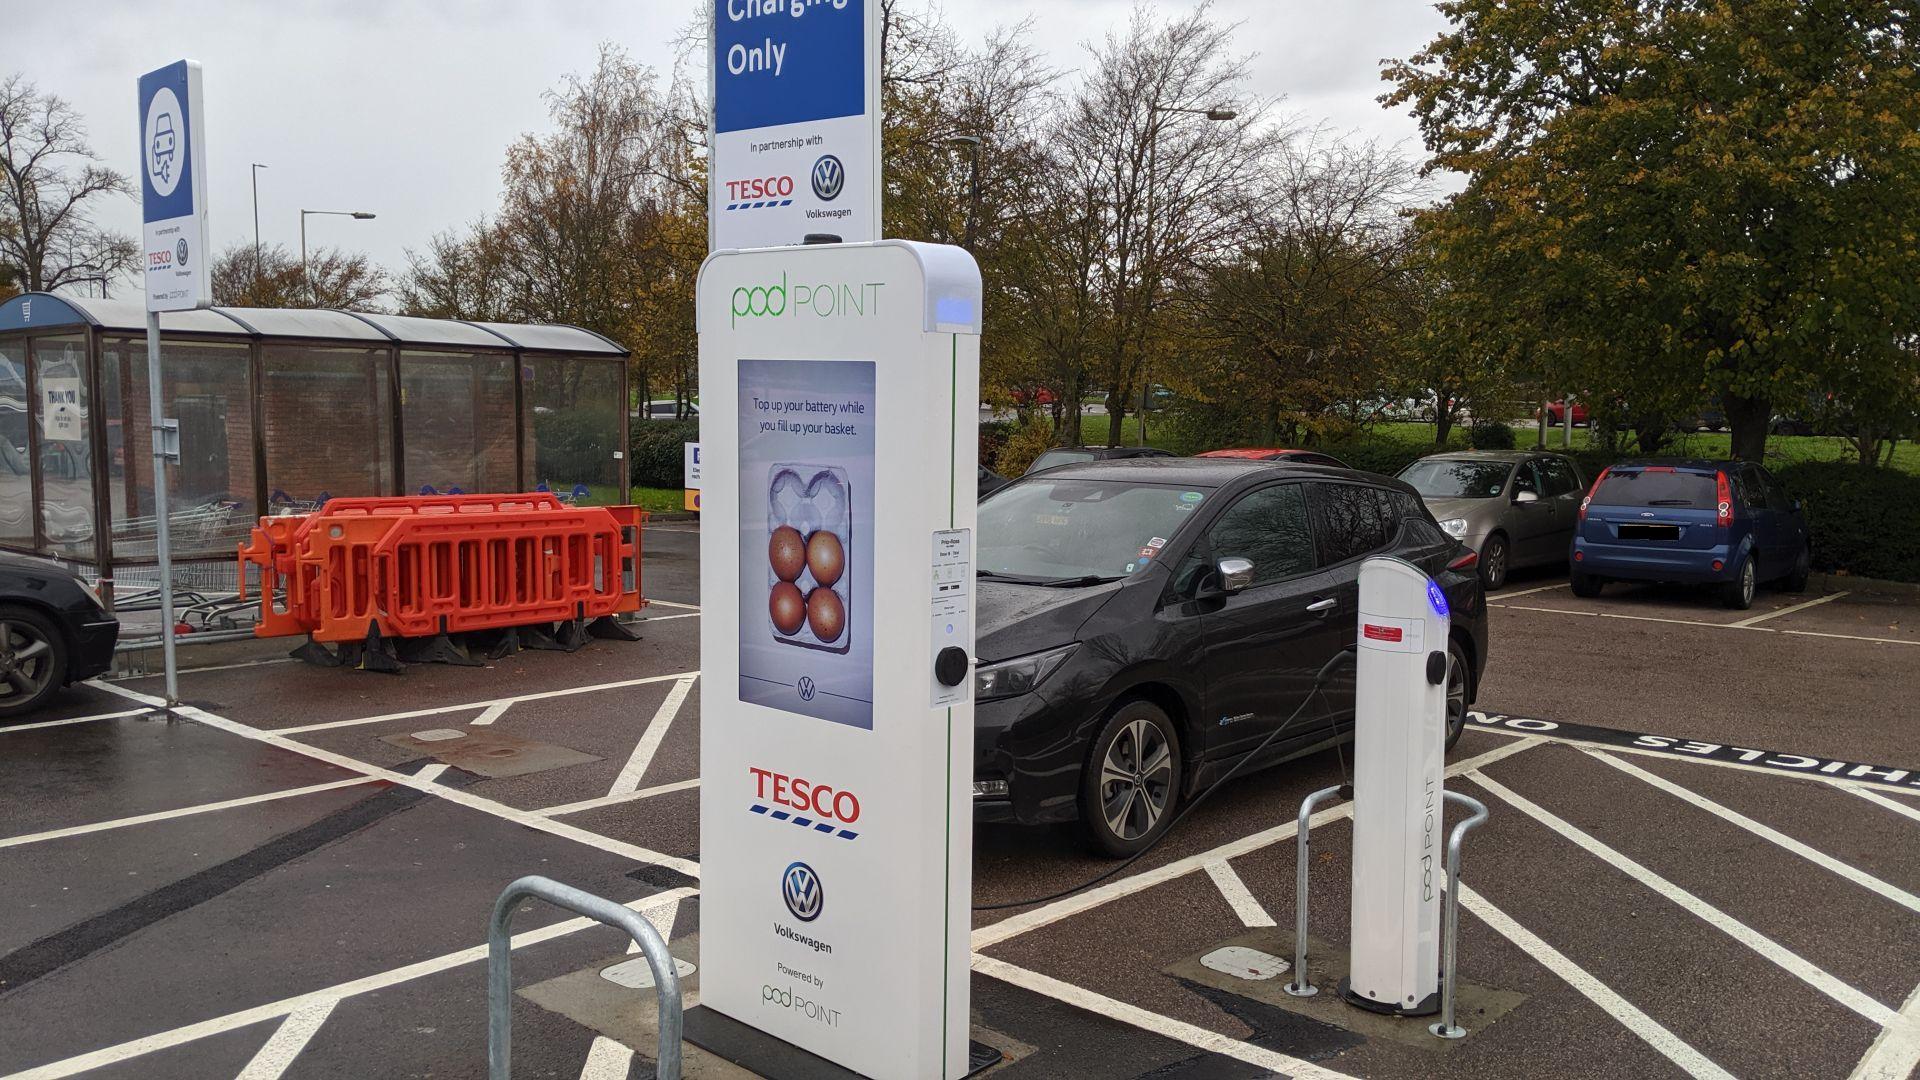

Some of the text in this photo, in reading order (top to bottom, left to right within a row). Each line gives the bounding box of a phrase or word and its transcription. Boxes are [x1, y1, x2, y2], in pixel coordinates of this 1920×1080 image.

[727, 0, 847, 21] Charg
[727, 37, 786, 76] Only
[750, 134, 823, 154] In partnership with
[726, 176, 794, 200] TESCO
[806, 207, 852, 219] Volkswagen
[148, 250, 172, 265] TESCO
[732, 270, 885, 330] pod POINT
[753, 397, 865, 415] Top up your battery while
[760, 420, 857, 436] you fill up your basket.
[1633, 735, 1920, 786] HICLES
[749, 767, 860, 824] TESCO
[1421, 776, 1434, 903] pod POINT
[773, 922, 832, 954] Volkswagen
[777, 962, 824, 990] Powered by
[762, 984, 842, 1028] pod POINT
